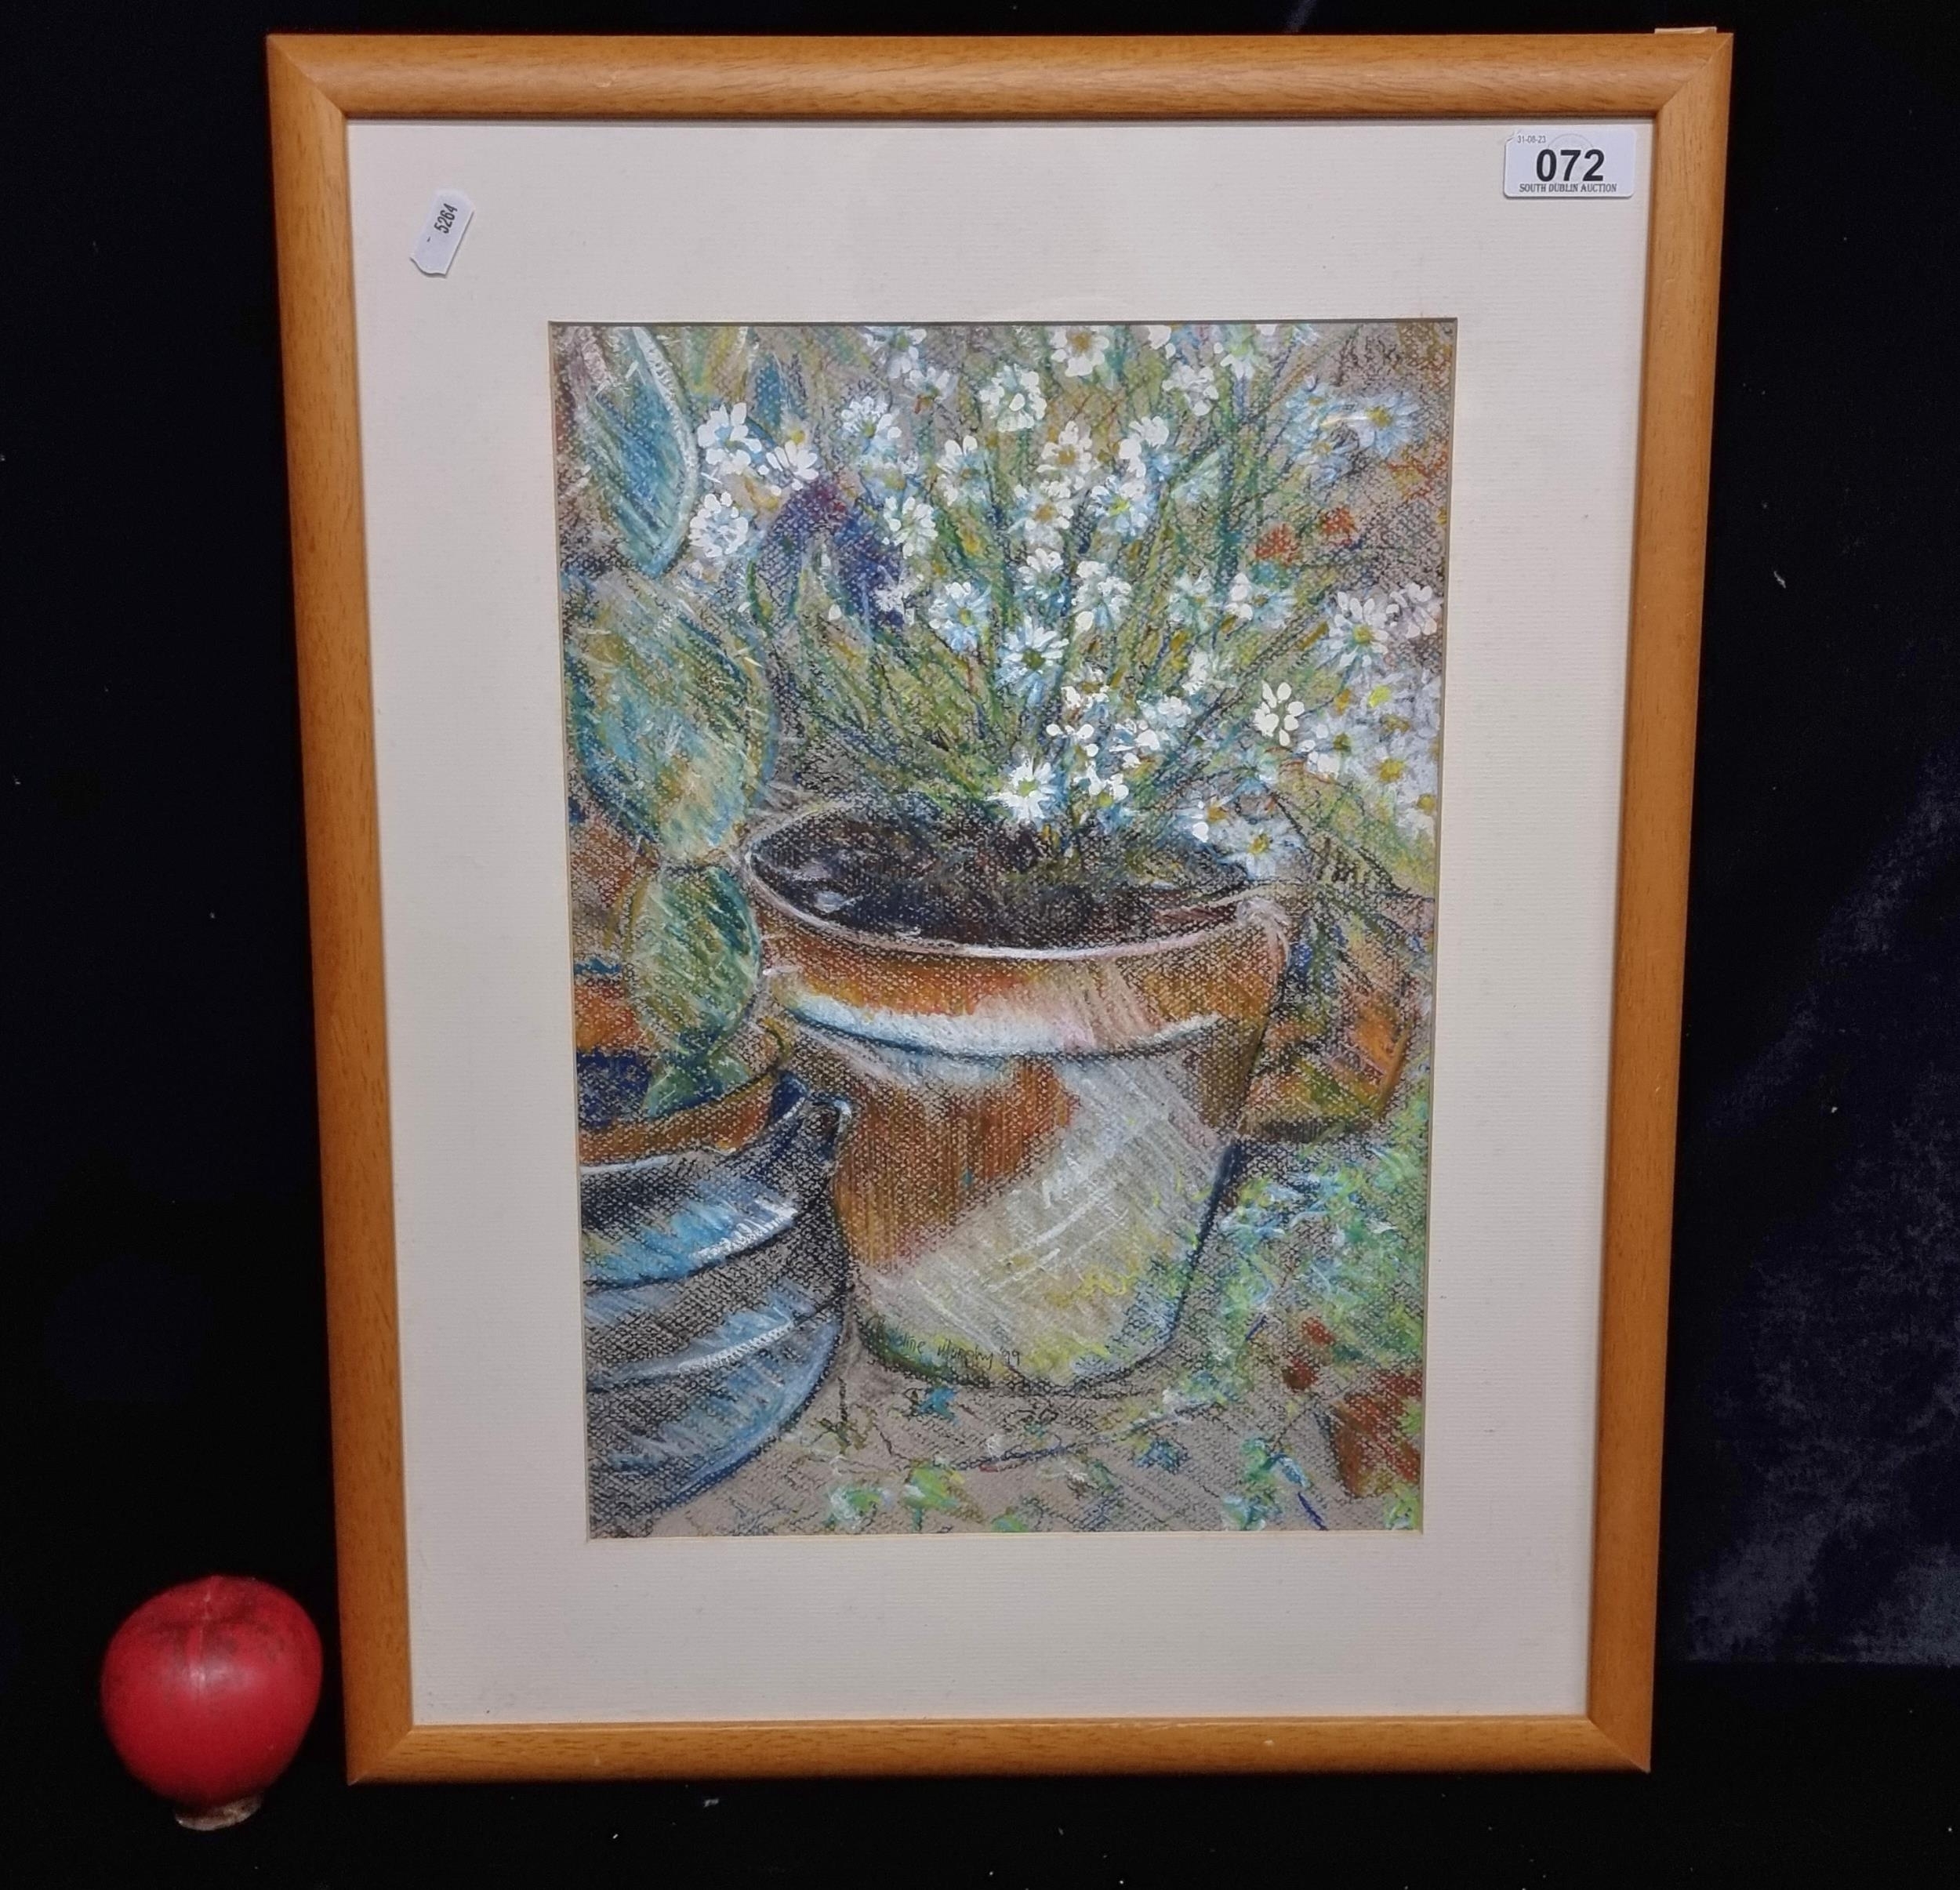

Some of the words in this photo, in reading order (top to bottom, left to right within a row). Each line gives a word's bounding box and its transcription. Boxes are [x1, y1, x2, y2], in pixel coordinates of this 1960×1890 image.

[1517, 135, 1546, 143] 31-08-23
[1536, 149, 1605, 182] 072
[1519, 183, 1547, 193] SOUTH
[1548, 183, 1578, 192] DUBLIN
[1580, 183, 1617, 192] AUCTION
[434, 203, 458, 234] 5264
